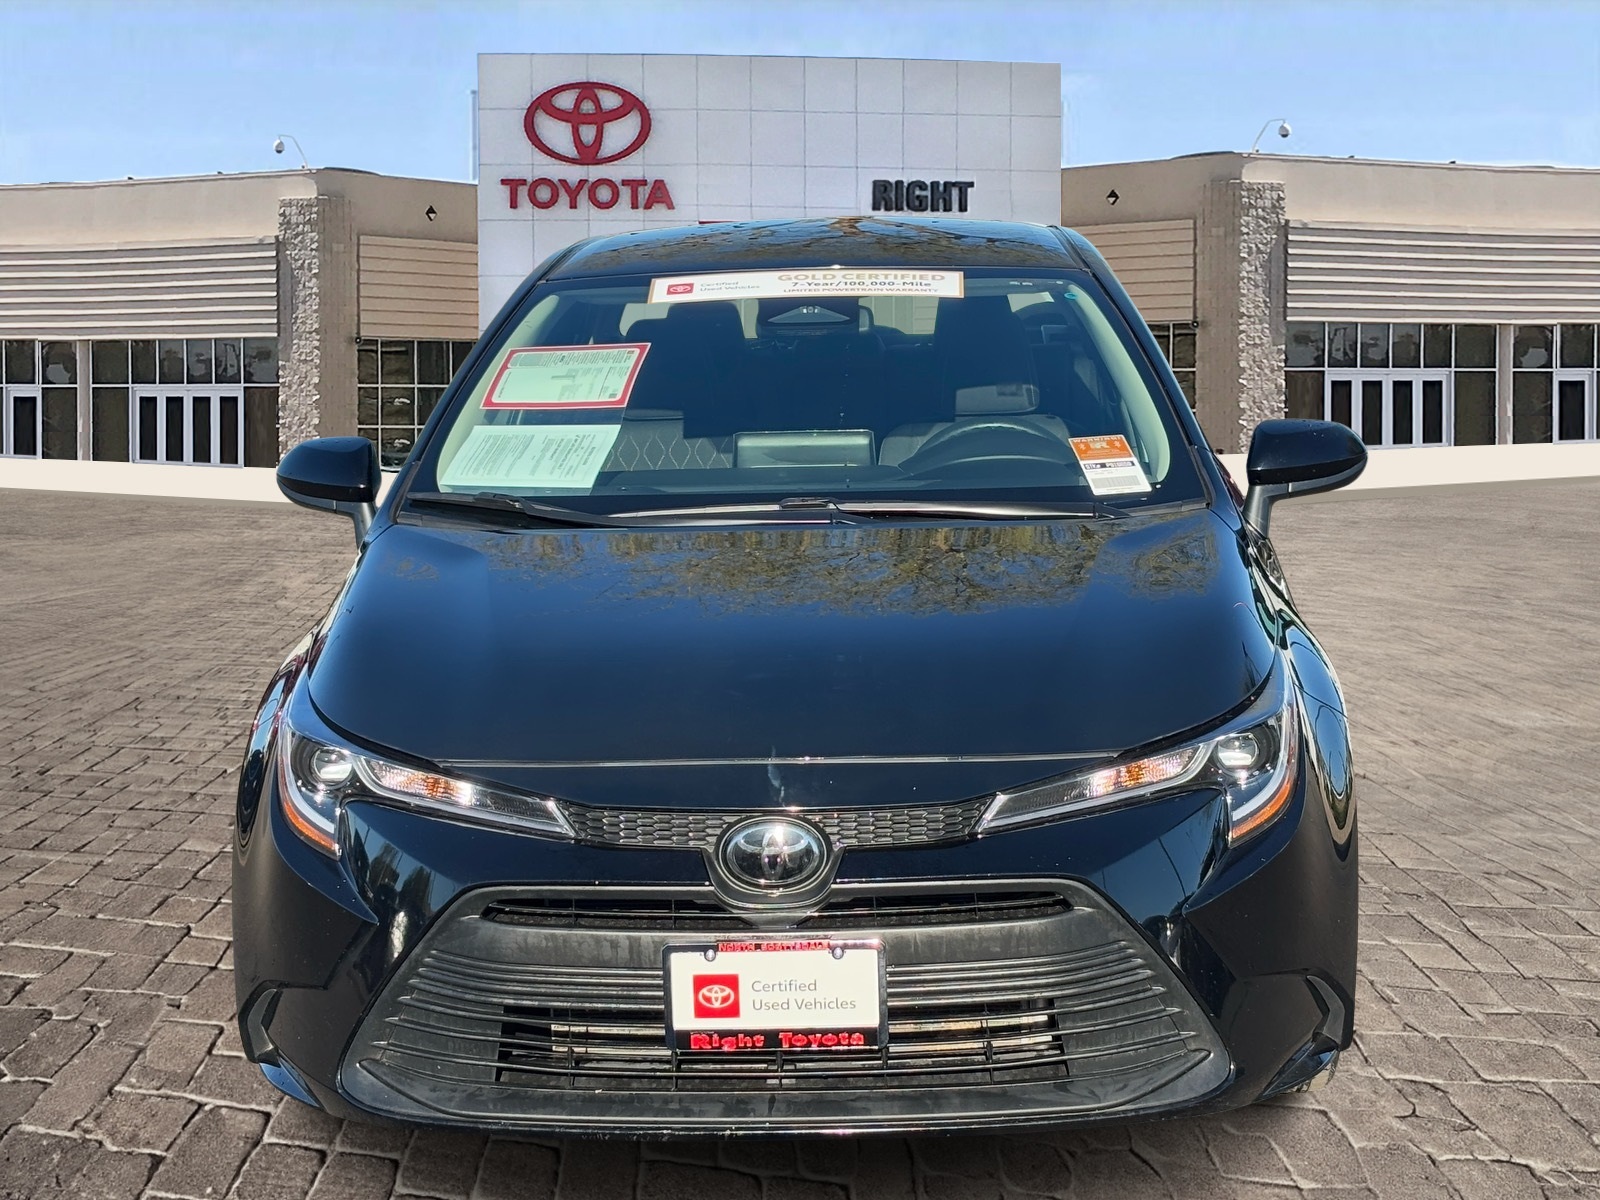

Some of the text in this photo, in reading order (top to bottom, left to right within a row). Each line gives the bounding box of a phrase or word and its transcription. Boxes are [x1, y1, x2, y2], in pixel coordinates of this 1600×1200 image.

[500, 178, 675, 210] TOYOTA
[872, 180, 975, 213] RIGHT
[777, 272, 945, 283] GOLD CERTIFIED
[751, 979, 817, 993] Certified
[752, 997, 857, 1011] Used Vehicles
[690, 1031, 865, 1051] Right Toyota
